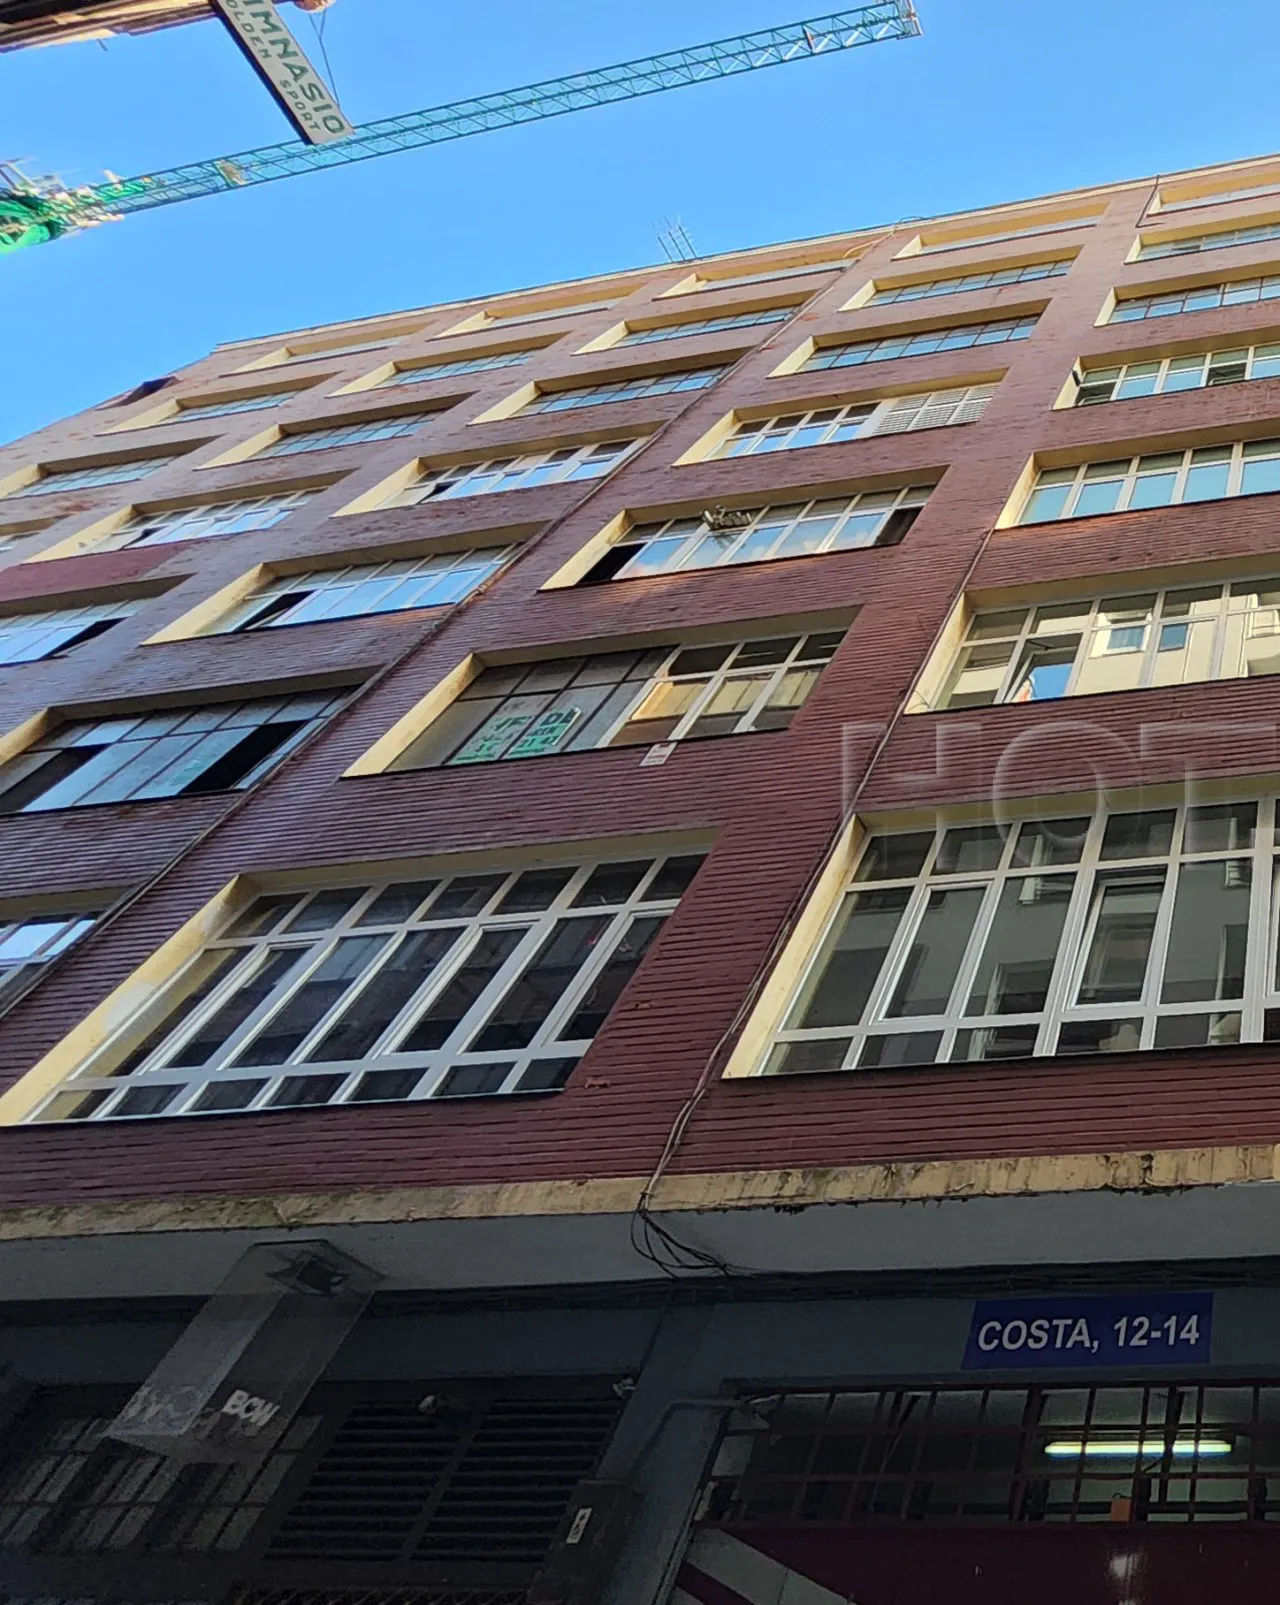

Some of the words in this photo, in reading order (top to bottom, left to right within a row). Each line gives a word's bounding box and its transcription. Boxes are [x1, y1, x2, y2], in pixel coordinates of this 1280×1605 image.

[278, 78, 321, 131] SPORT
[978, 1318, 1100, 1354] COSTA,
[1113, 1314, 1200, 1347] 12-14
